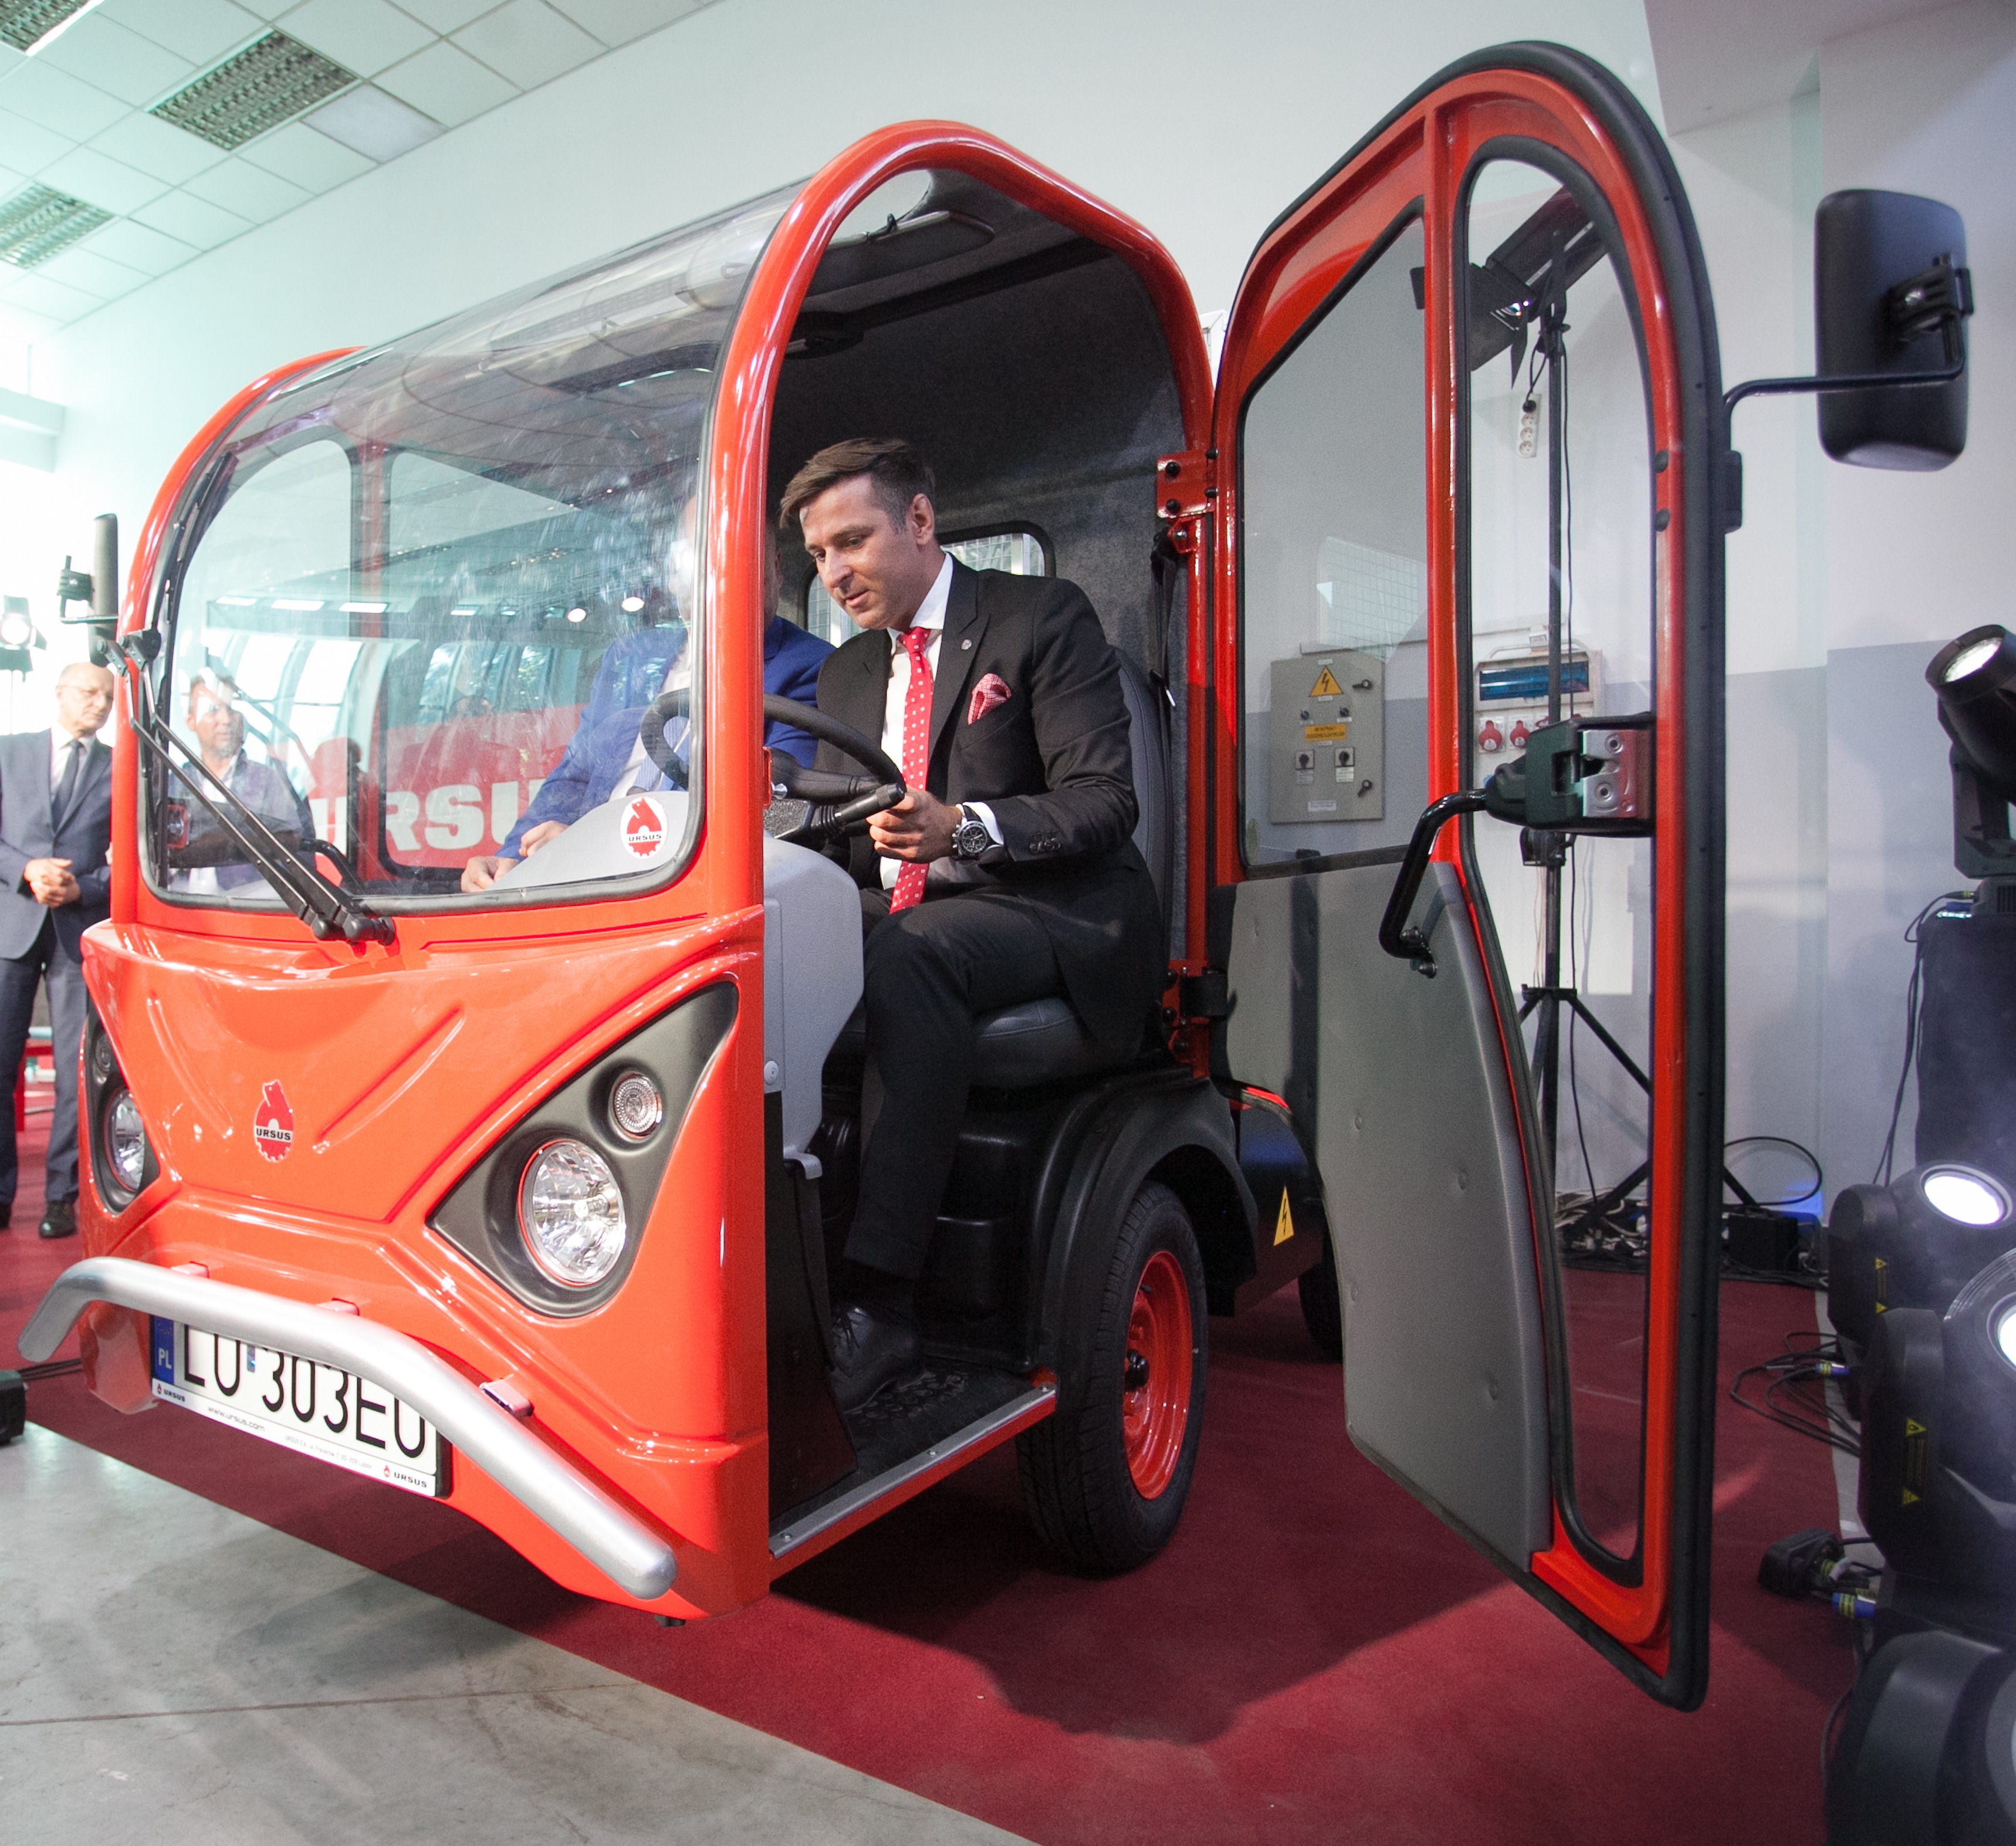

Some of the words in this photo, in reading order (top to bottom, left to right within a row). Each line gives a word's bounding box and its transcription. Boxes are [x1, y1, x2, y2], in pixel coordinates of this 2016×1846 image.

[256, 1128, 291, 1141] URSUS
[158, 1348, 172, 1370] PL
[164, 1388, 185, 1402] URSUS
[208, 1406, 265, 1432] www.ursus.com
[394, 1472, 427, 1488] URSUS
